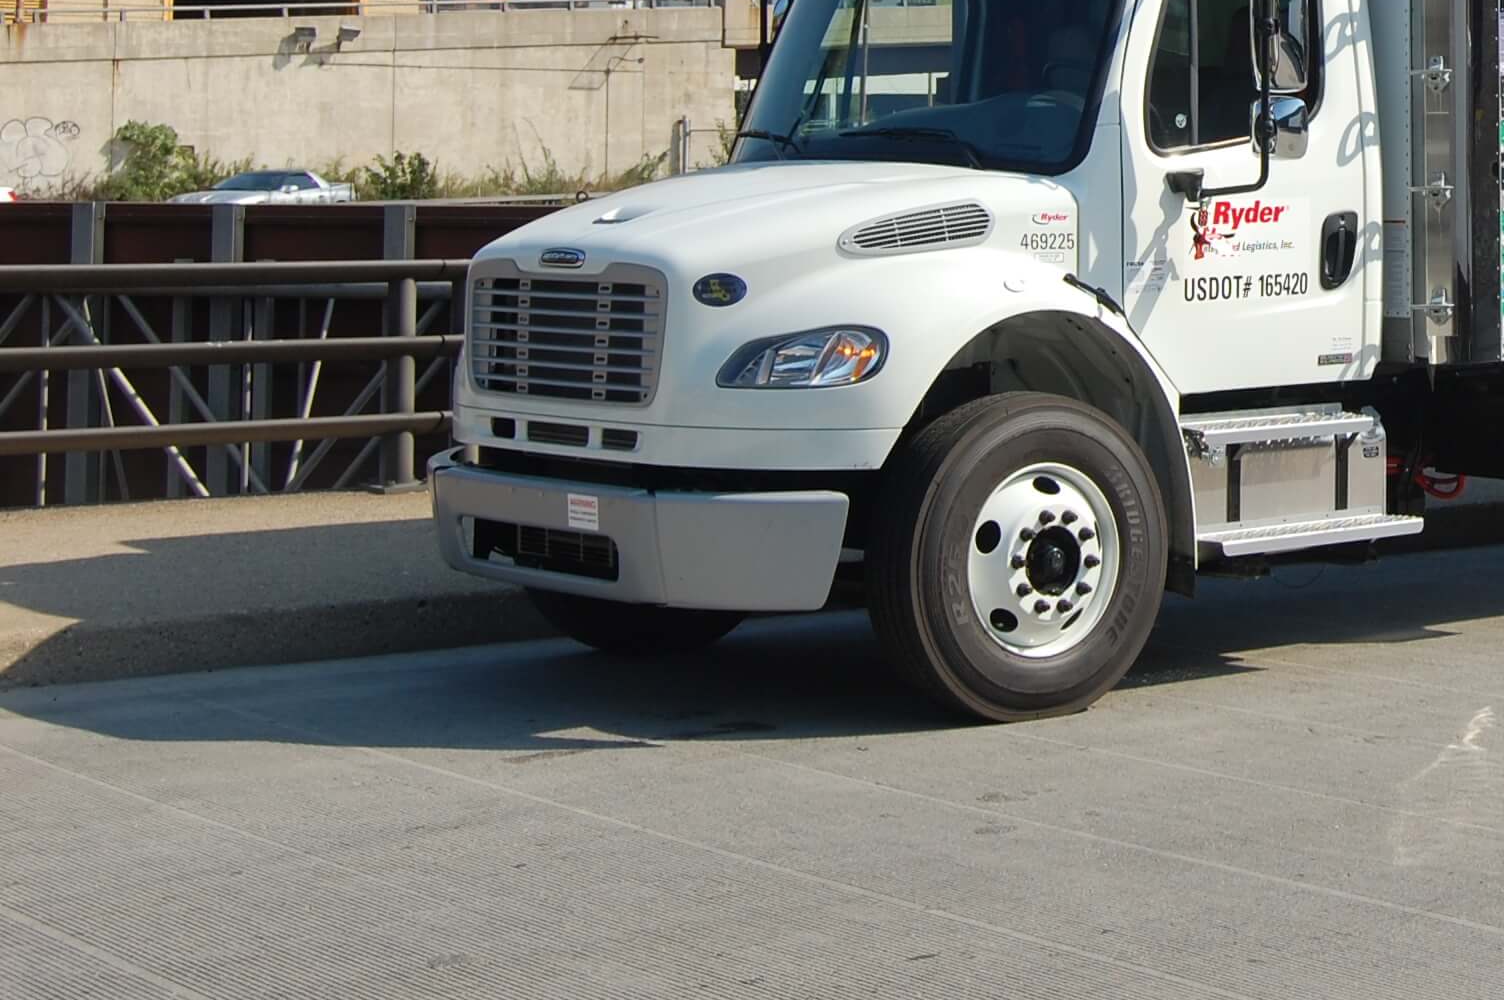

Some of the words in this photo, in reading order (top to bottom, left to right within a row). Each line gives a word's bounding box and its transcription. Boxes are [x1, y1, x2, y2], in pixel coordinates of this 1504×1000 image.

[1040, 212, 1069, 222] Ryder
[1213, 200, 1285, 230] Ryder
[1020, 232, 1075, 250] 469225
[1184, 274, 1253, 302] USDOT#
[1258, 272, 1309, 297] 165420
